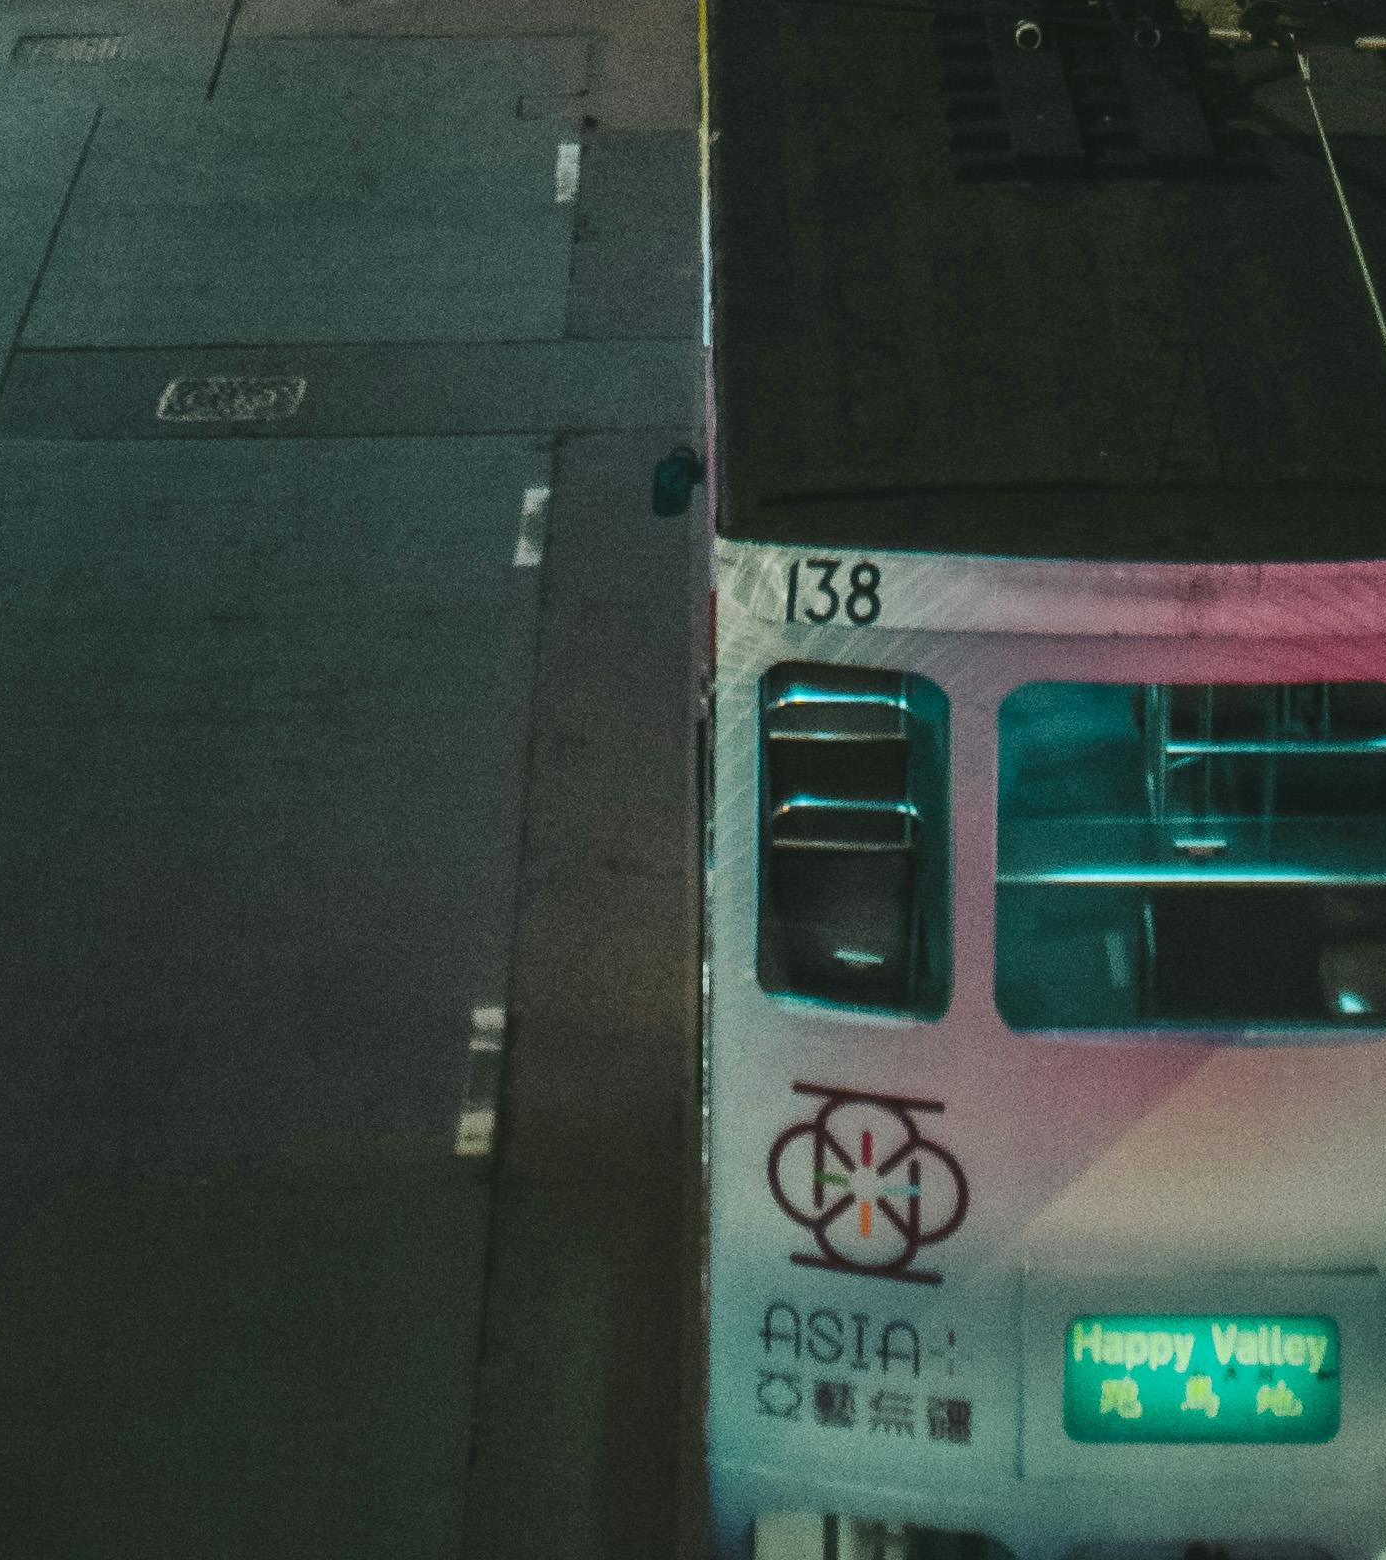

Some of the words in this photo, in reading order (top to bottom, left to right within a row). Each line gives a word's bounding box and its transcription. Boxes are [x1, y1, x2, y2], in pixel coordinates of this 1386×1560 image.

[786, 558, 882, 627] 138
[1072, 1321, 1195, 1373] Happy
[1211, 1321, 1328, 1373] Valley
